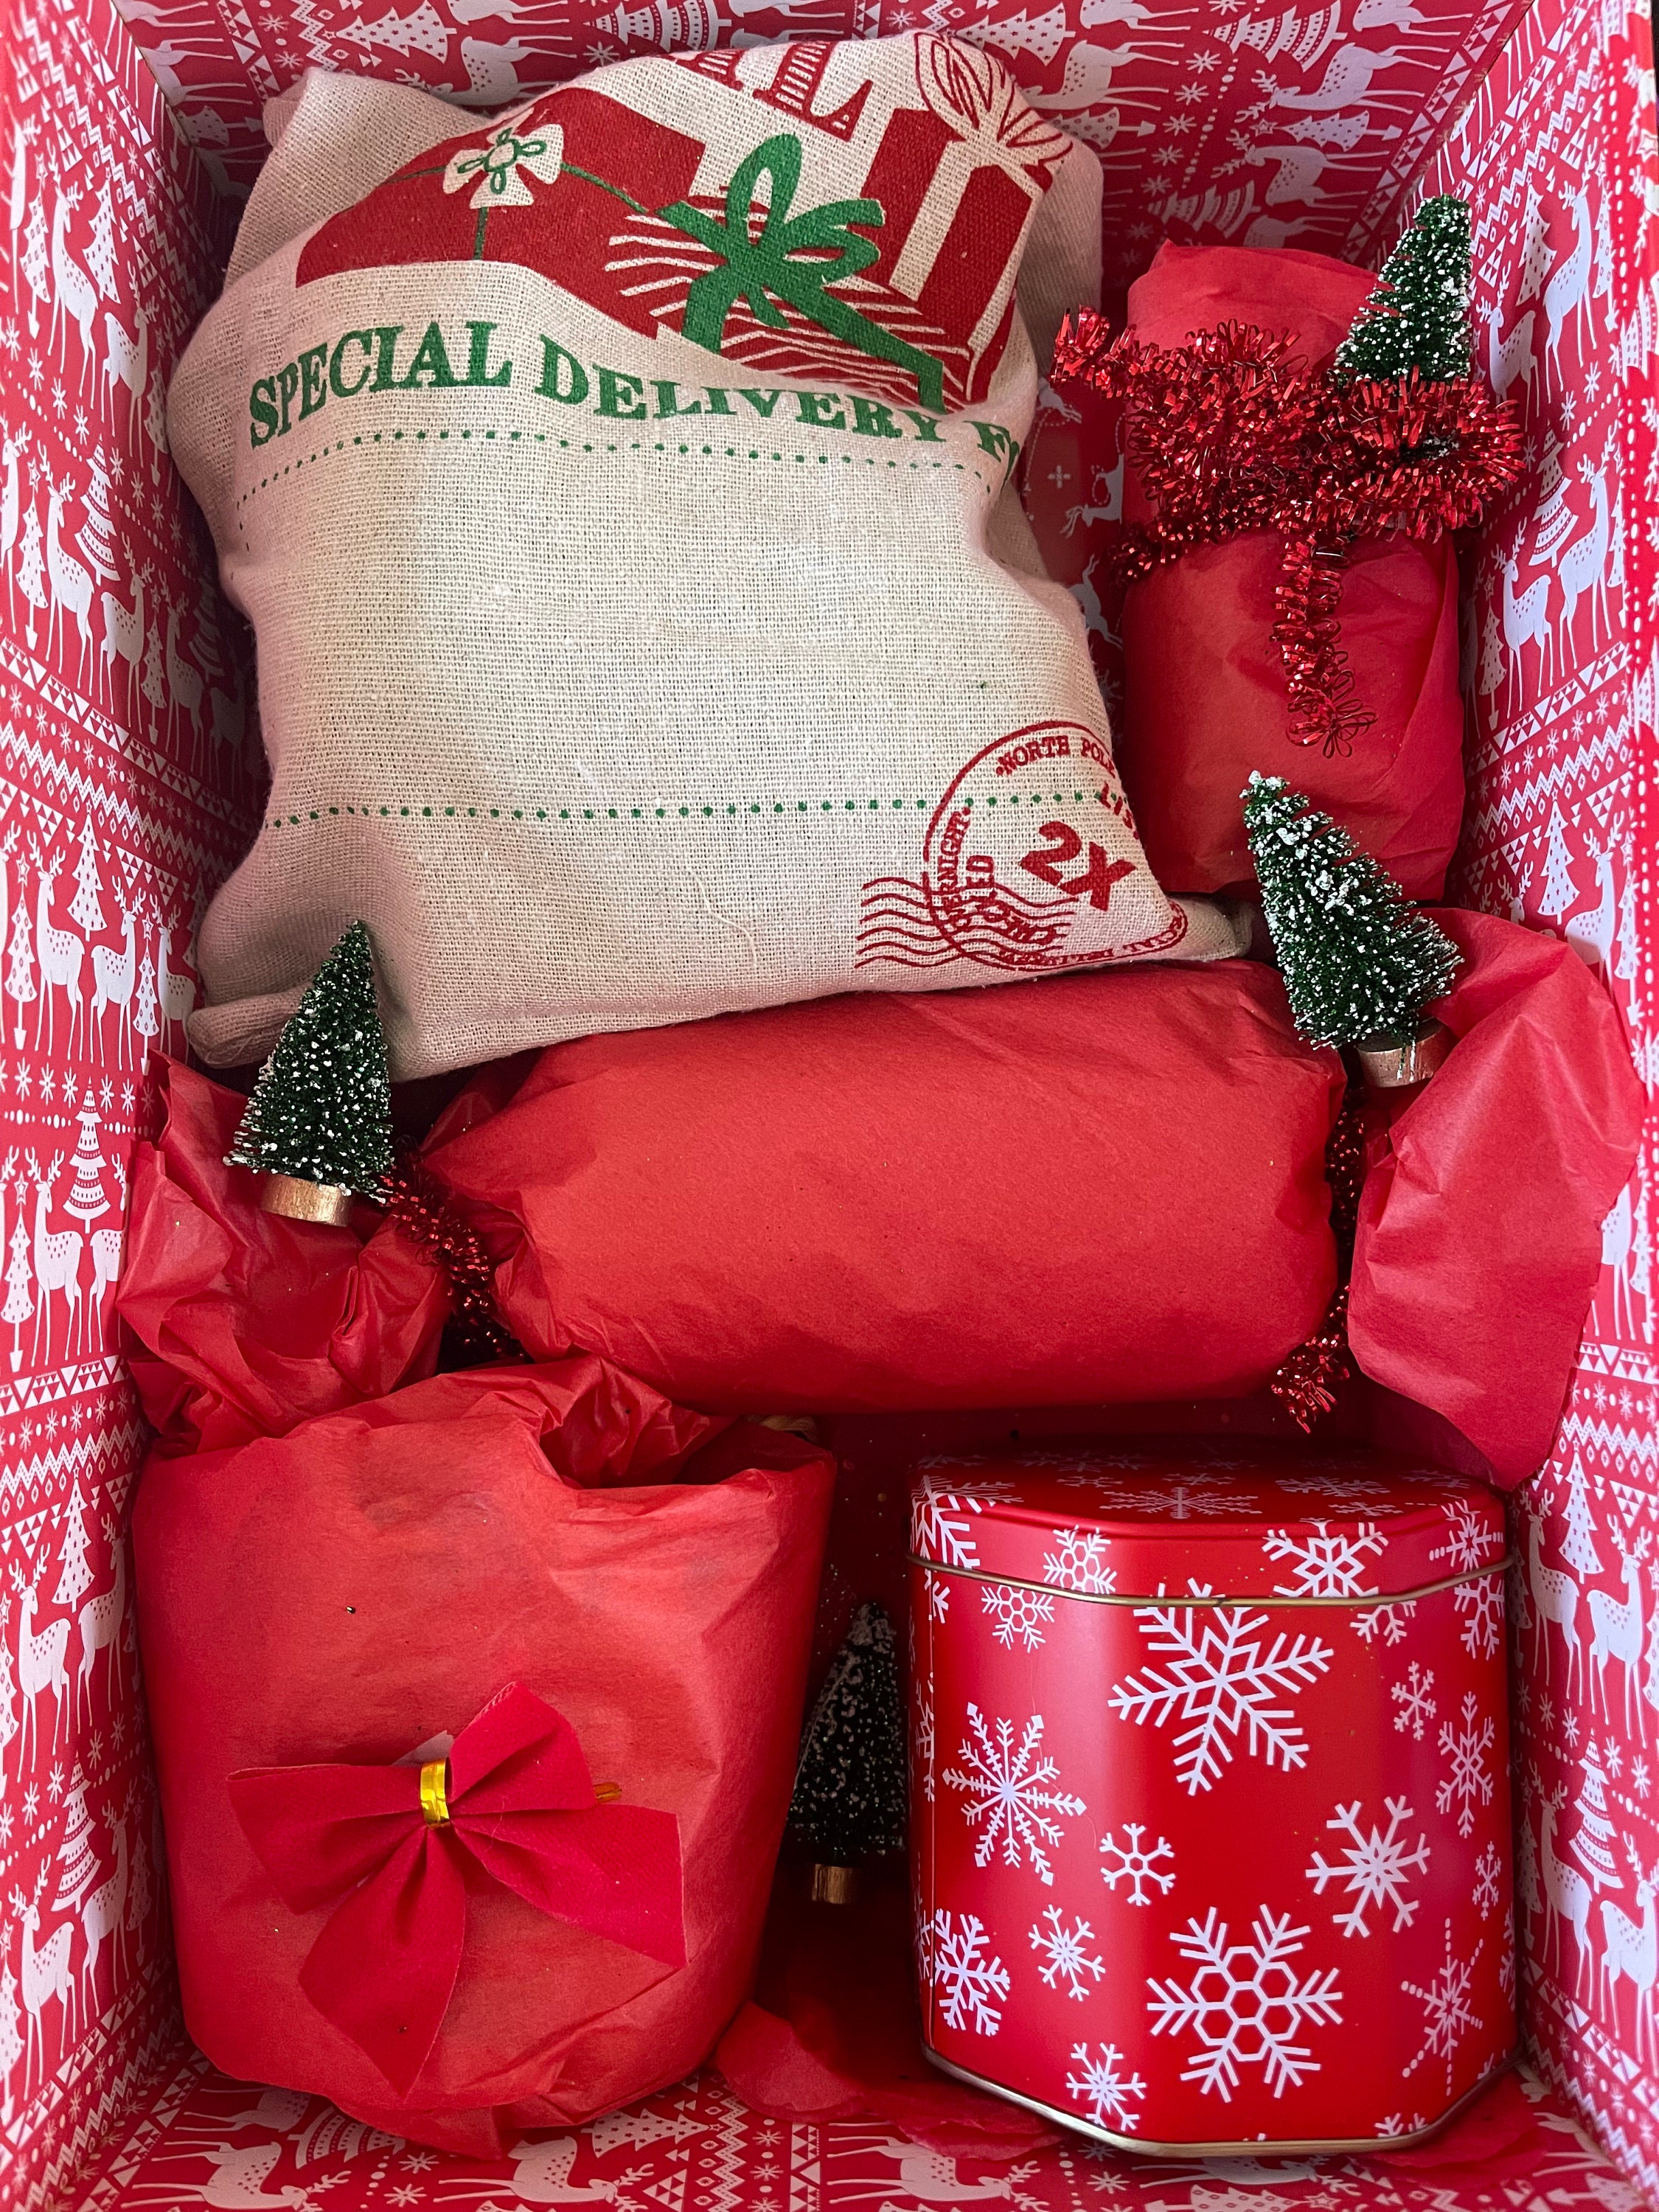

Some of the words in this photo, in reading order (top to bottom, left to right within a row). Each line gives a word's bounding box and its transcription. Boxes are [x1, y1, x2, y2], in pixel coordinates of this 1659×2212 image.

[248, 320, 512, 448] SPECIAL
[534, 333, 947, 443] DELIVERY
[998, 735, 1069, 776] NORTH
[1019, 821, 1136, 911] 2X
